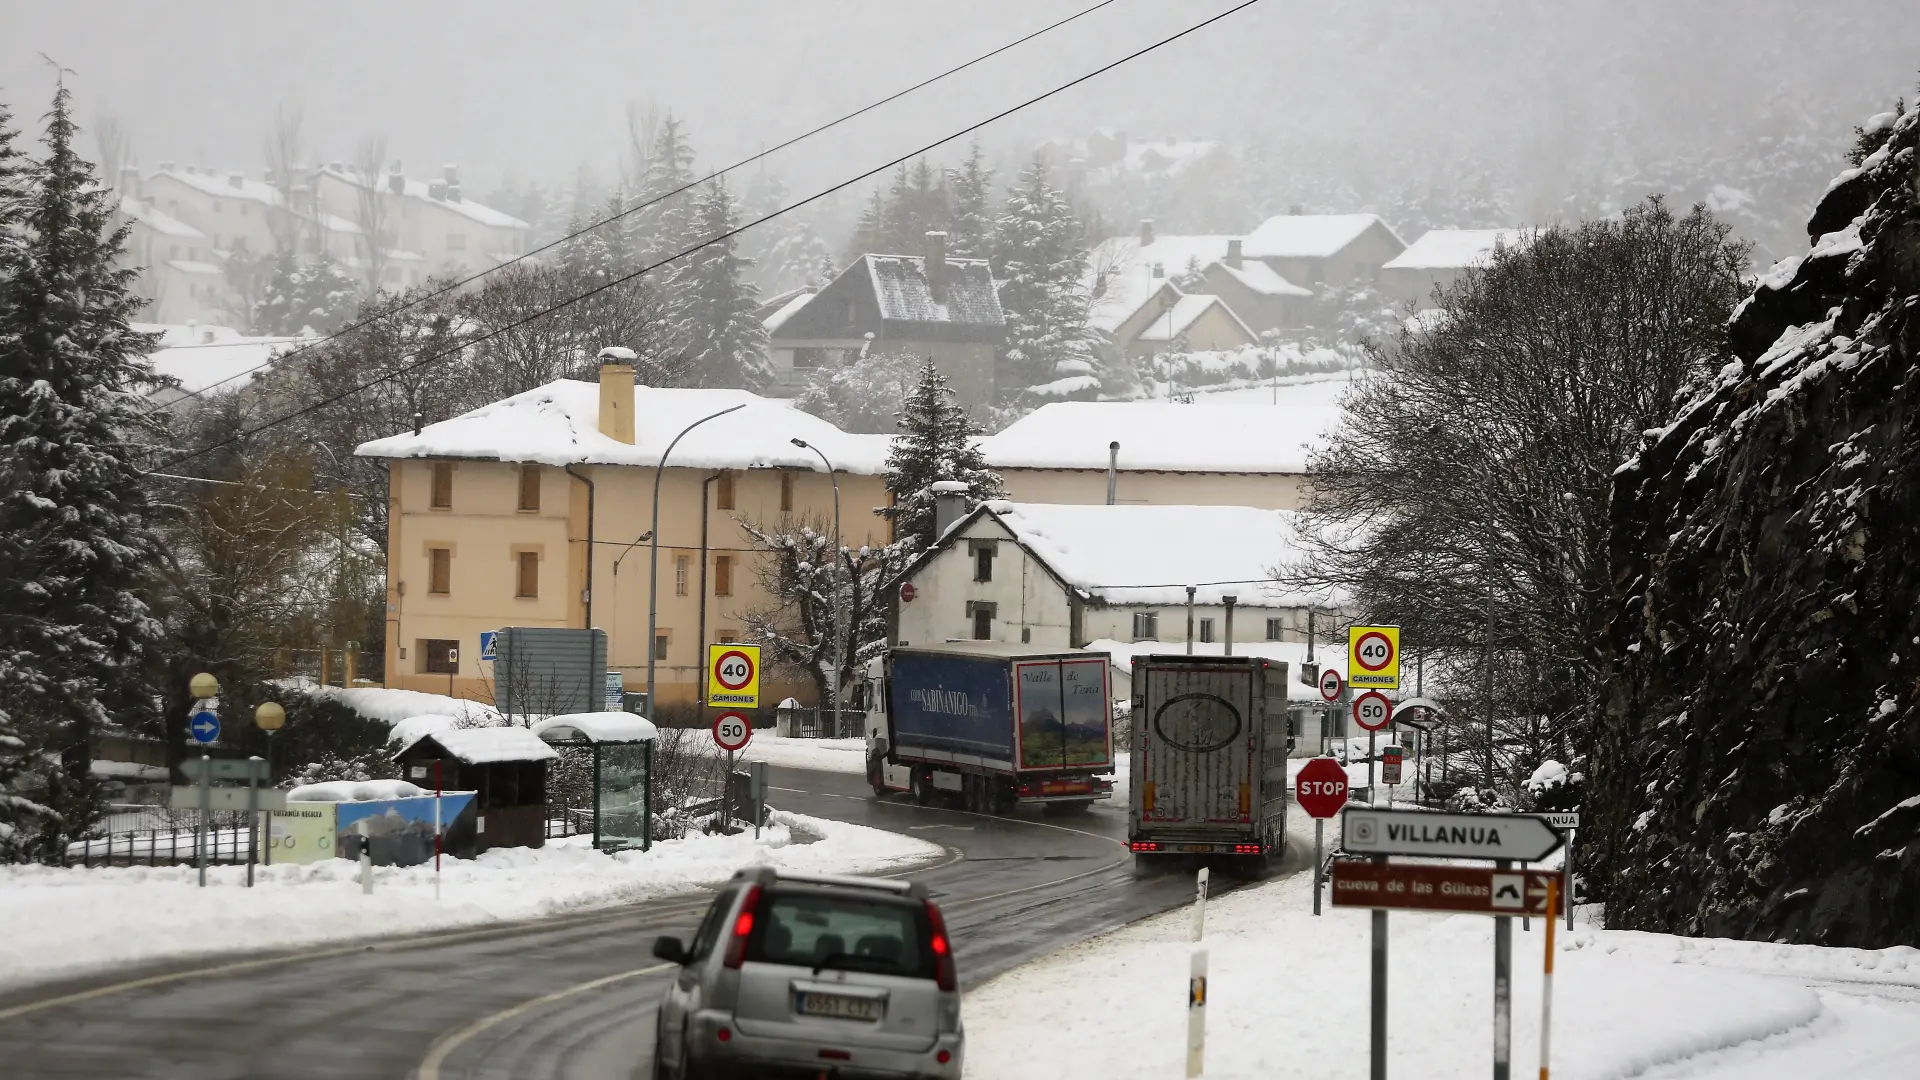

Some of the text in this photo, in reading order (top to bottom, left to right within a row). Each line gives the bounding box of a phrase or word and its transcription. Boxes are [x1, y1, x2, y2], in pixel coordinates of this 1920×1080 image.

[1362, 645, 1386, 657] 40
[723, 664, 746, 676] 40
[1022, 671, 1079, 682] Valle de
[1073, 684, 1100, 695] Tena
[1362, 705, 1383, 717] 50
[722, 725, 742, 737] 50
[1300, 781, 1345, 796] STOP
[1387, 822, 1502, 847] VILLANUA
[1337, 880, 1490, 897] cueva de las Güixas
